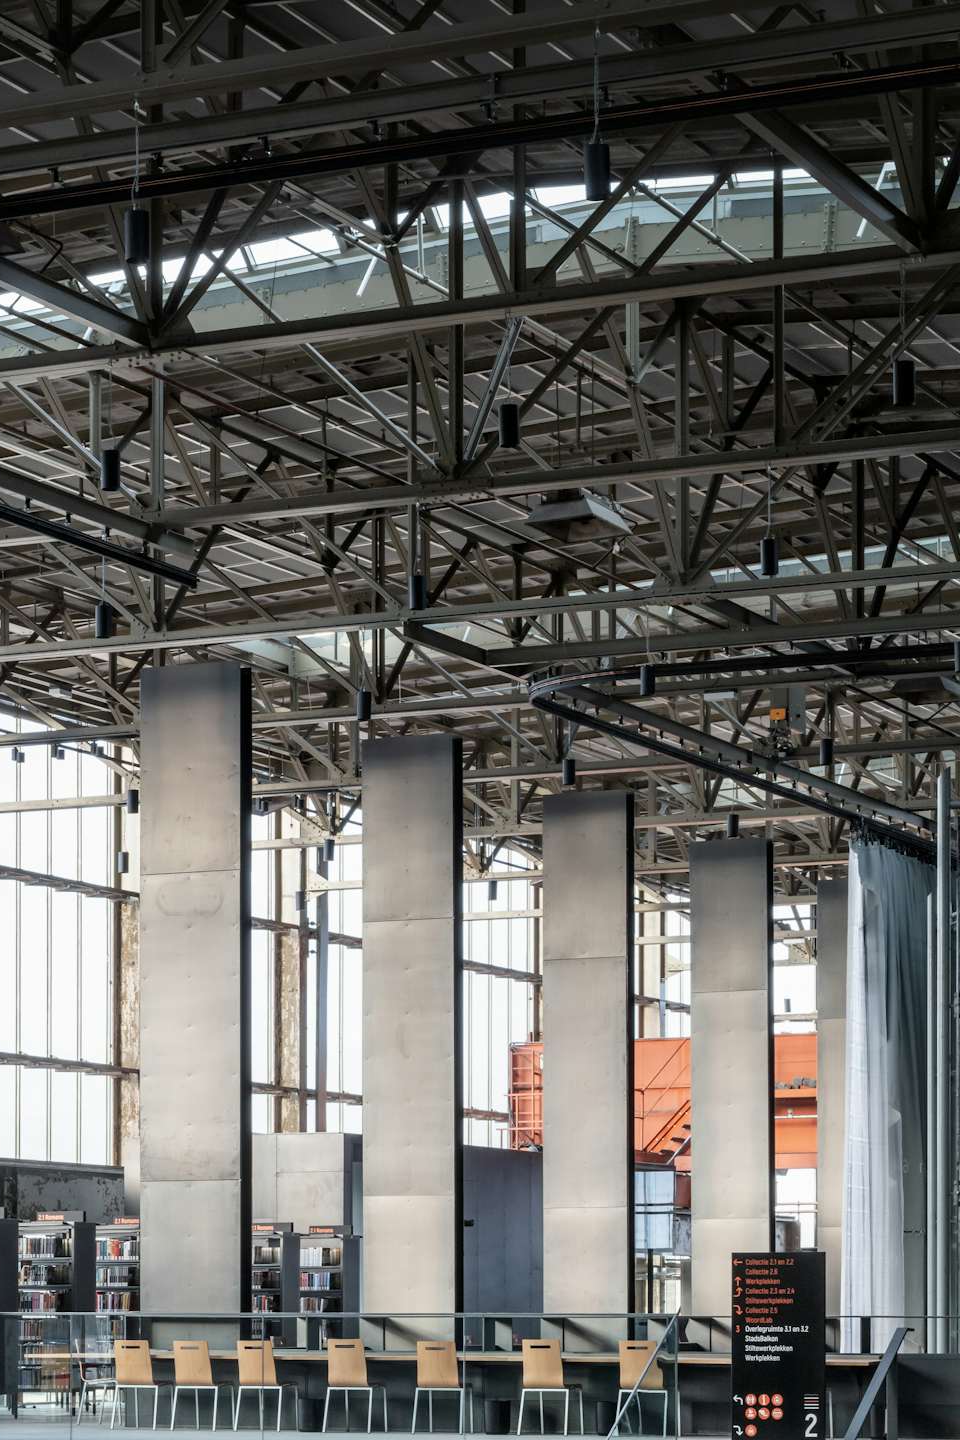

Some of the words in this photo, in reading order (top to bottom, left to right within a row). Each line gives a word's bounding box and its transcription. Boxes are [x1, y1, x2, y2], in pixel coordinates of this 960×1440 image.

[736, 1325, 740, 1333] 3
[745, 1325, 783, 1333] Overlegruimte
[745, 1354, 780, 1362] Werkplekken
[804, 1413, 818, 1438] 2
